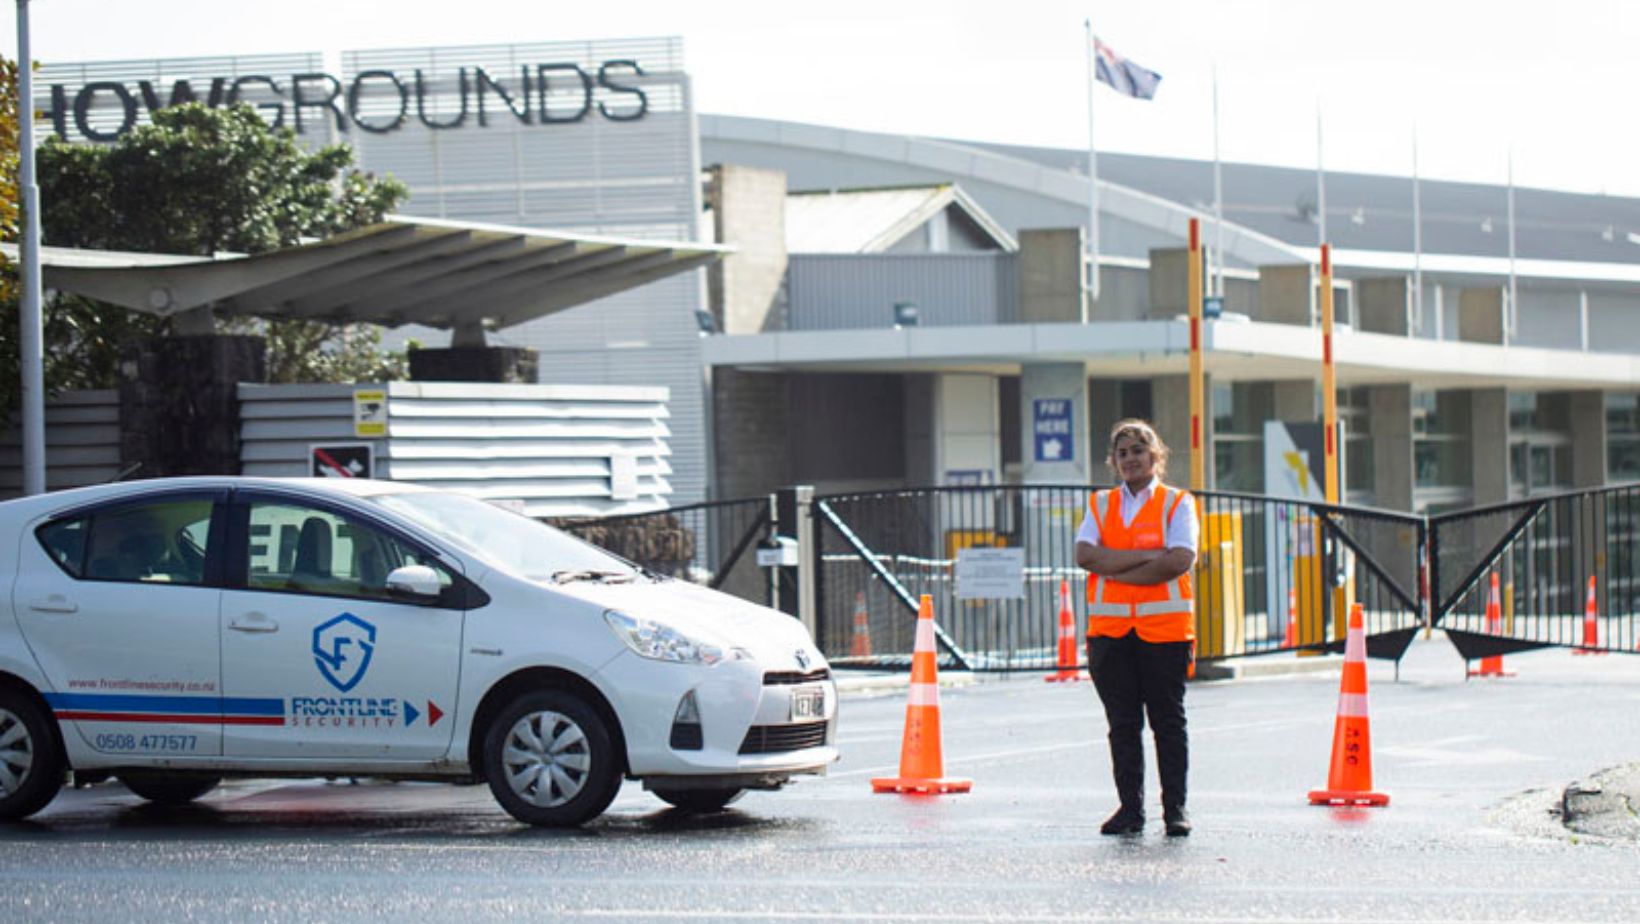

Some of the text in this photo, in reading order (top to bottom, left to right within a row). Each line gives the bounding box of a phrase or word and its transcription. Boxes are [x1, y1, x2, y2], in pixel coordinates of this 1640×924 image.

[292, 697, 398, 716] FRONTLINE
[292, 717, 395, 727] SECURITY
[96, 734, 197, 750] 0508 477577
